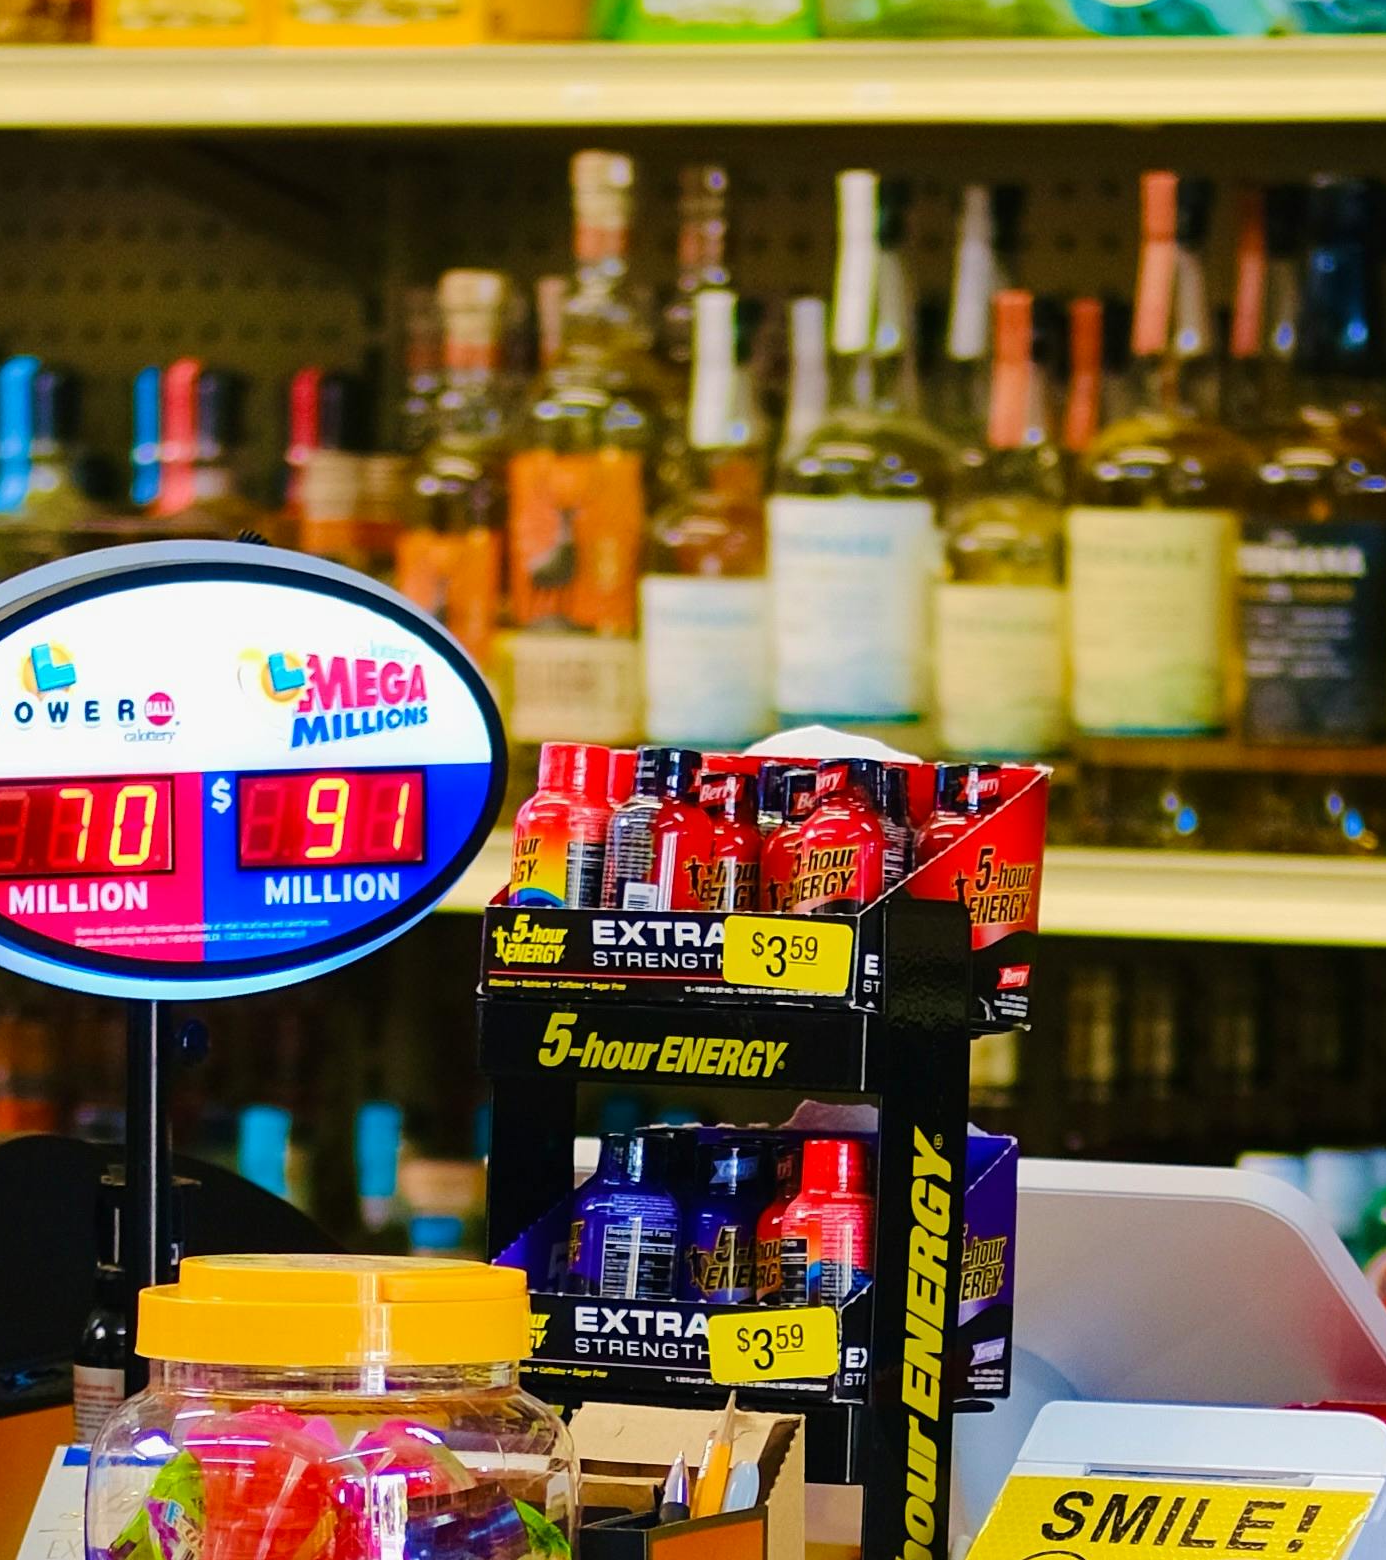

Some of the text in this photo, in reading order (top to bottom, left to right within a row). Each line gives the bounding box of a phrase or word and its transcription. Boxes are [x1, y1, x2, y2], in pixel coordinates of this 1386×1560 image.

[296, 653, 429, 714] MEGA
[289, 706, 429, 749] MILLIONS
[58, 783, 158, 868] 70
[211, 777, 412, 859] $ 91
[263, 871, 401, 906] MILLION
[975, 847, 1035, 892] 5-hour
[7, 880, 150, 916] MILLION
[967, 891, 1031, 925] ENERGY
[511, 913, 569, 944] 5-hour
[505, 942, 566, 965] ENERGY
[538, 1011, 788, 1079] 5-hour ENERGY
[901, 1124, 952, 1423] ENERGY
[573, 1305, 710, 1339] EXTRA
[1040, 1489, 1323, 1554] SMILE!
